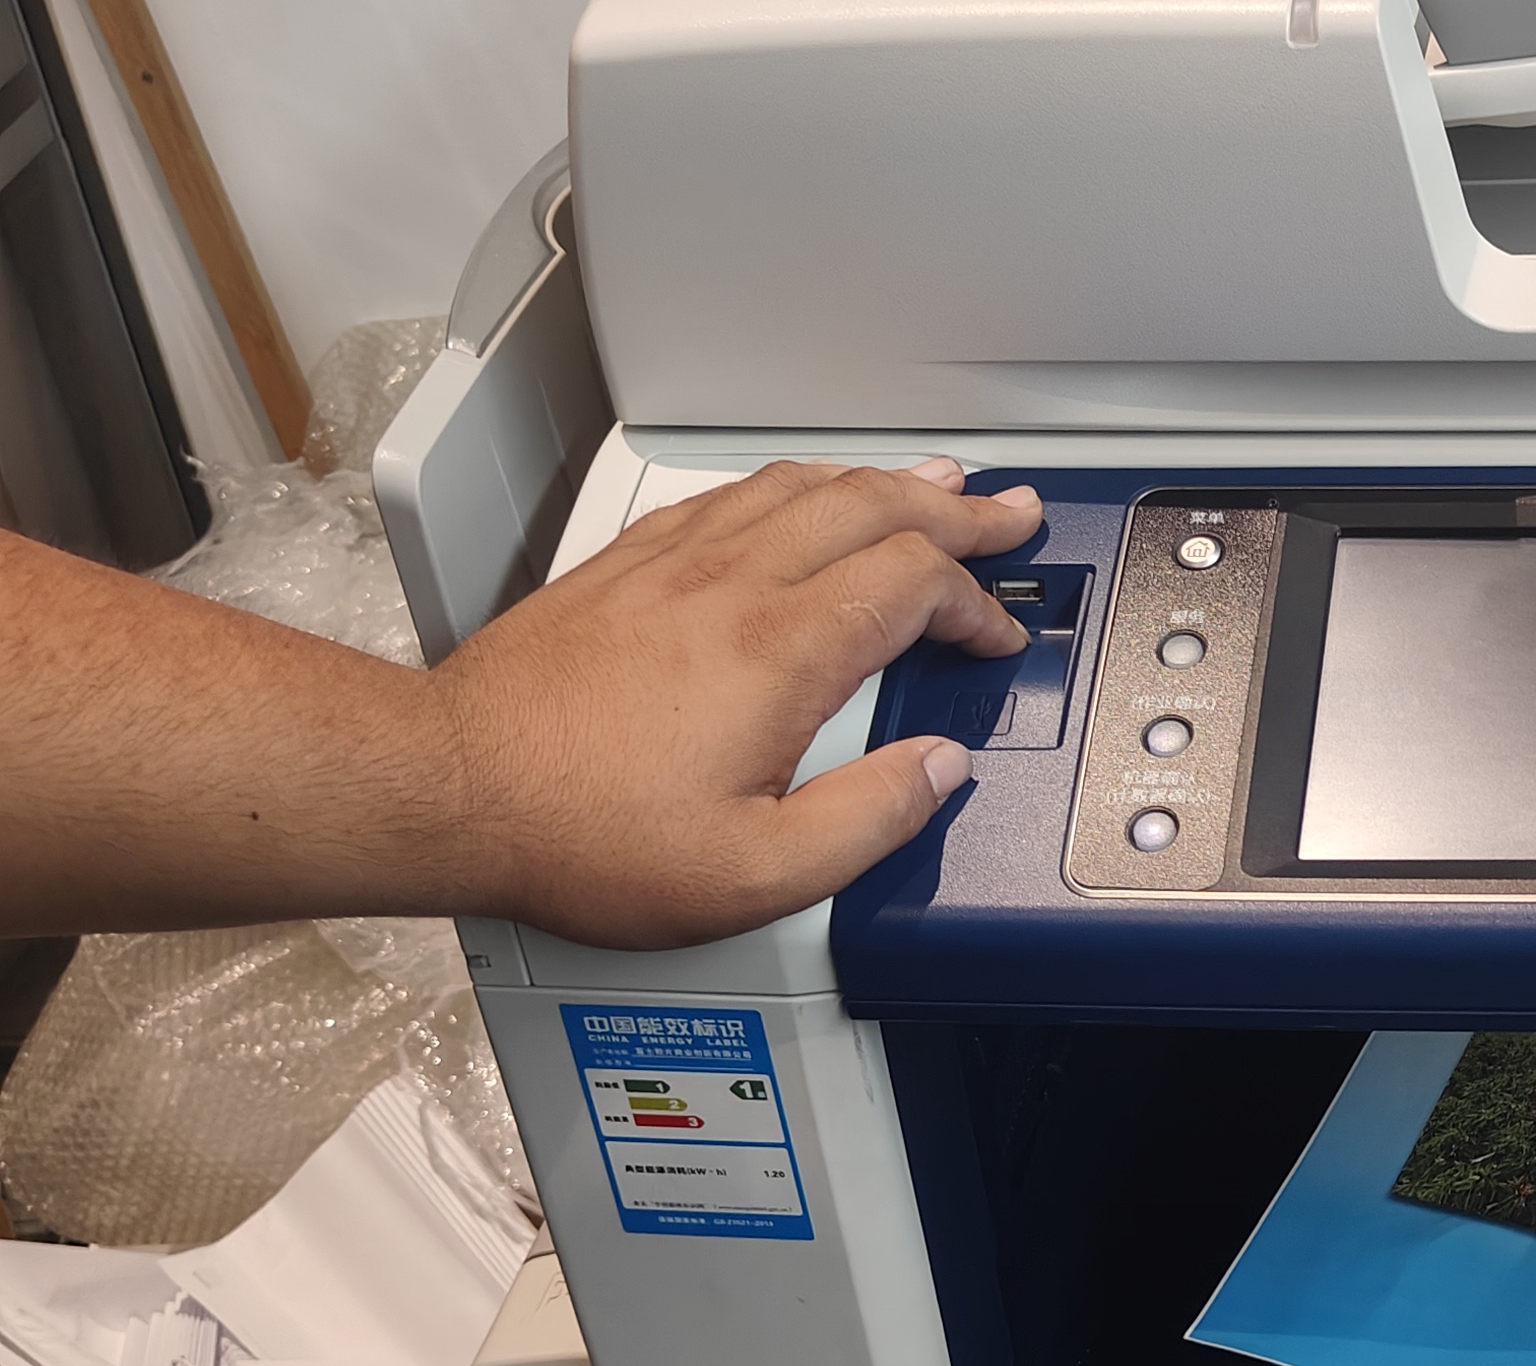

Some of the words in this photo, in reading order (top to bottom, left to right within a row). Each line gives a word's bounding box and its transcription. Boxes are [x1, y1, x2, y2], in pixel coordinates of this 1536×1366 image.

[583, 1016, 746, 1038] 中国能效标识
[588, 1035, 630, 1043] CHINA
[642, 1036, 693, 1045] ENERGY
[706, 1039, 748, 1047] LABEL
[656, 1083, 665, 1093] 1
[669, 1100, 680, 1109] 2
[688, 1117, 699, 1127] 3
